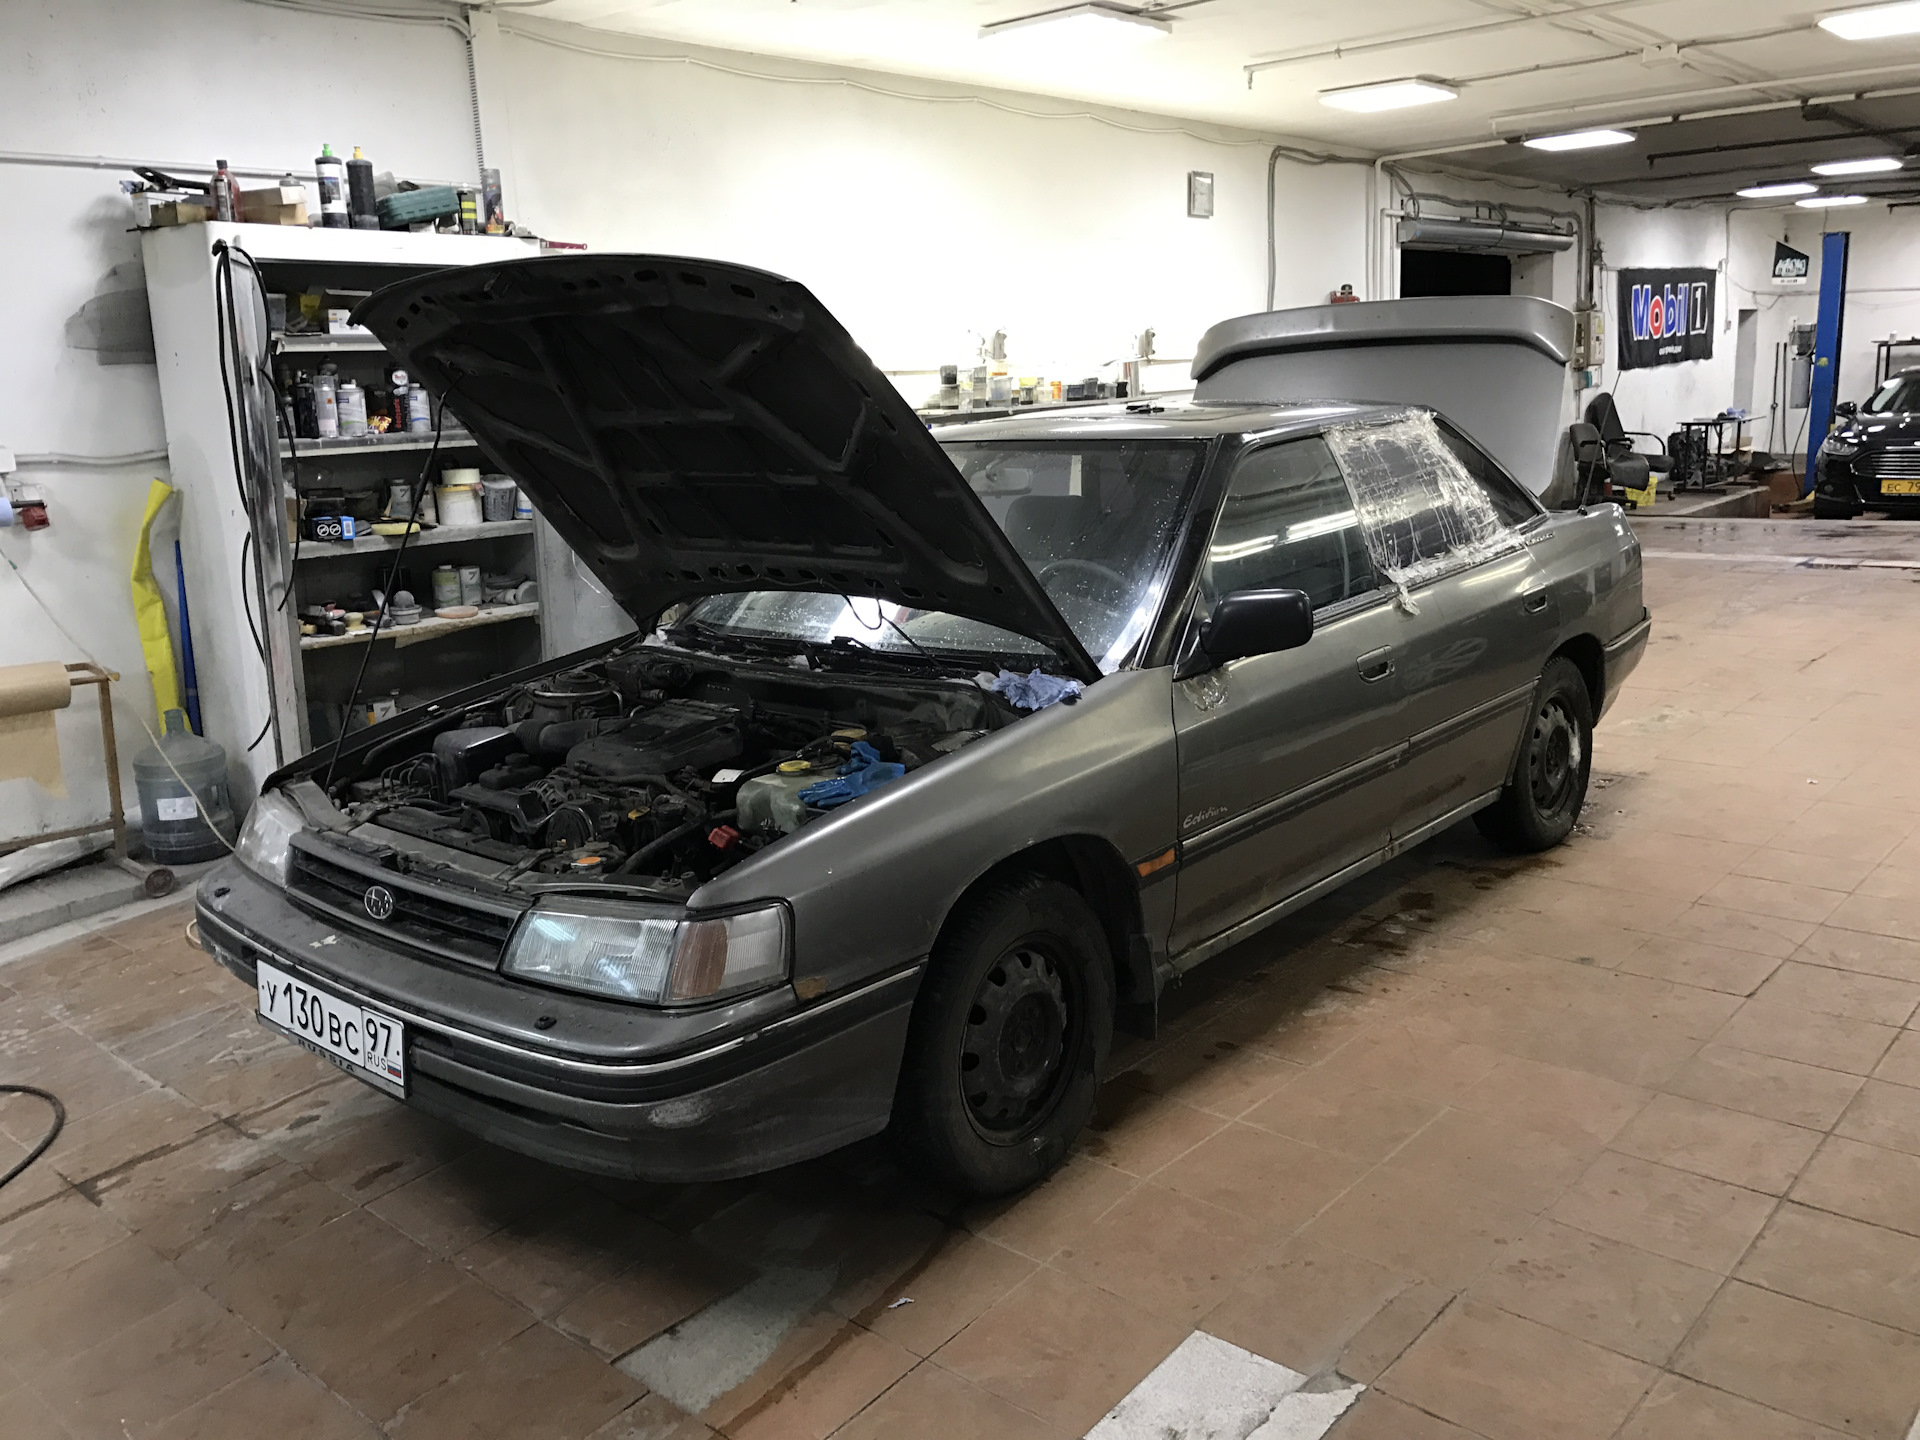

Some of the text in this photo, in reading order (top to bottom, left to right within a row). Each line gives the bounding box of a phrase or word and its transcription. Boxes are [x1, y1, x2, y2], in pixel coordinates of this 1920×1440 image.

[1631, 283, 1689, 341] Mobil
[1183, 806, 1228, 829] Edition
[366, 1017, 391, 1057] 97
[367, 1051, 387, 1071] RUS
